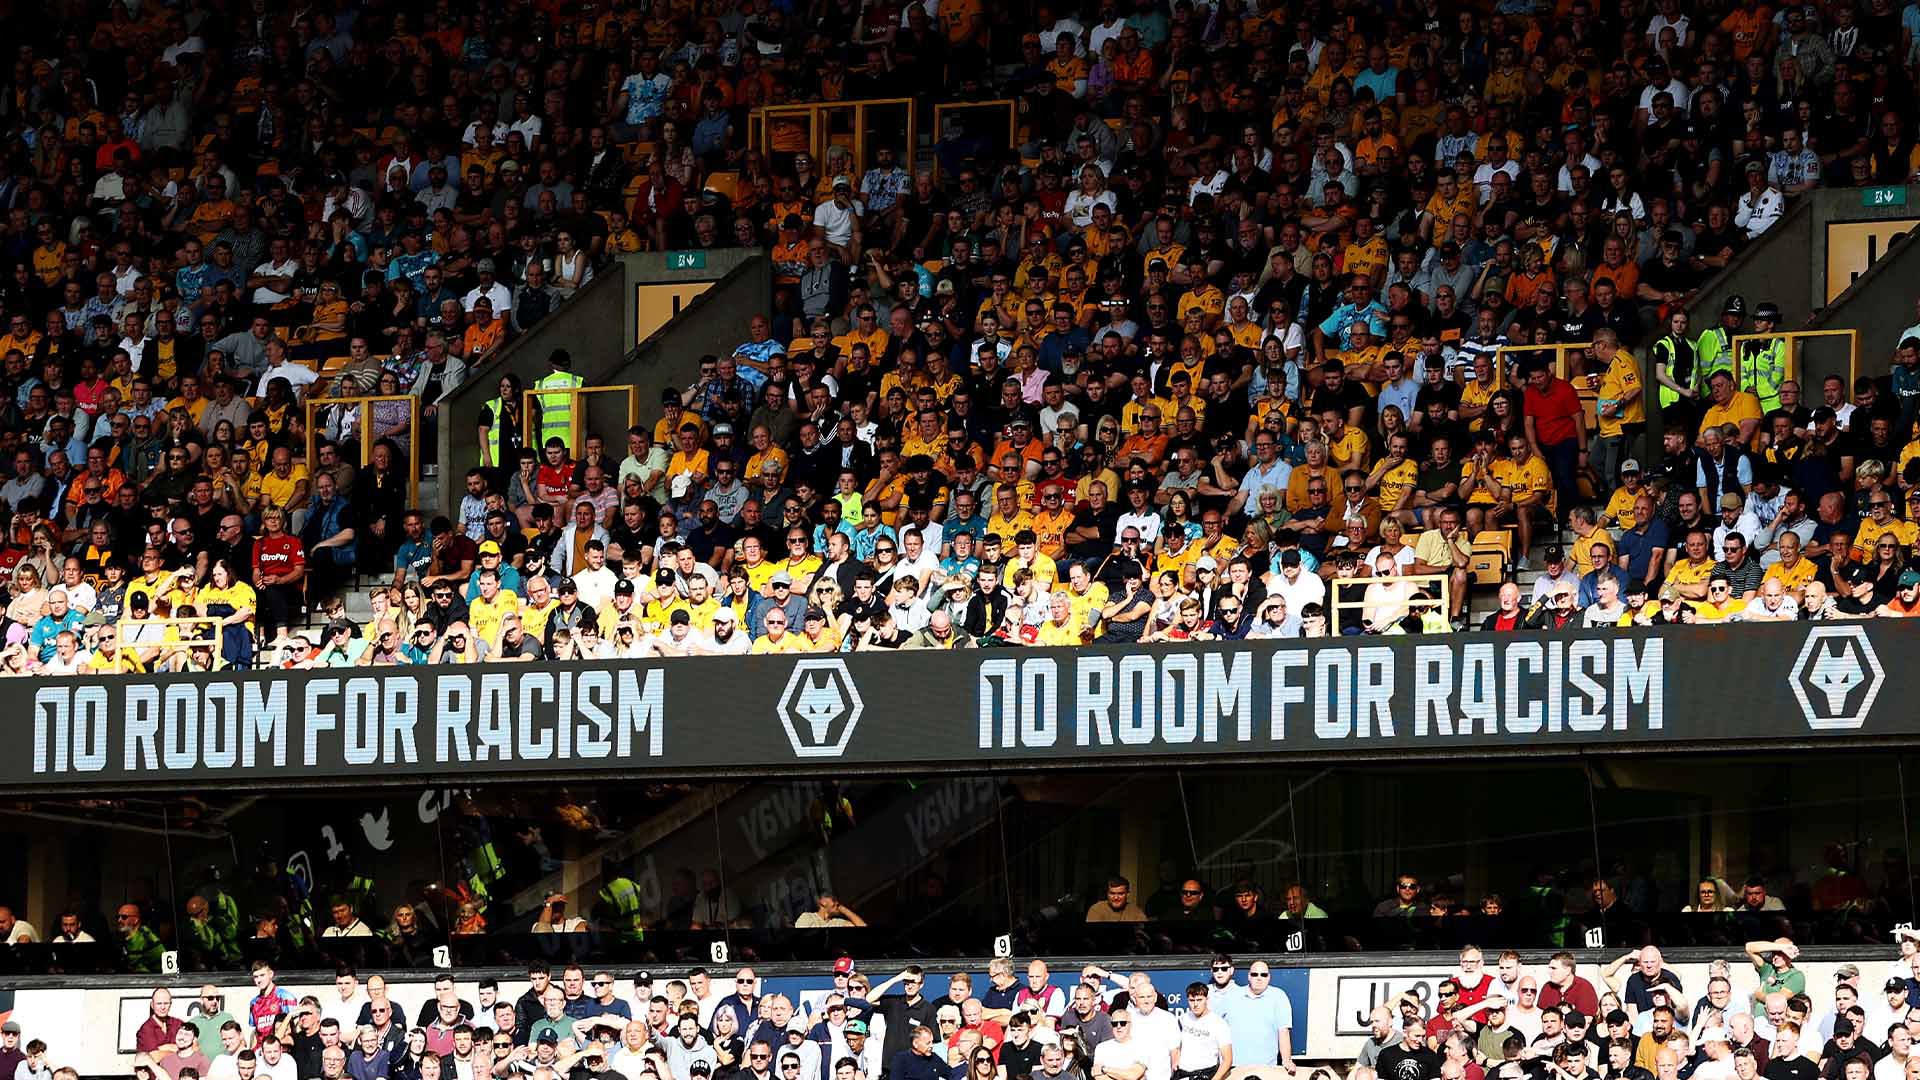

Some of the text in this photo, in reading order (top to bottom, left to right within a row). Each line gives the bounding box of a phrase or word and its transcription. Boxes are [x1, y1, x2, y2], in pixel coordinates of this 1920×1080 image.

[979, 638, 1663, 748] NO ROOM FOR RACISM
[34, 669, 664, 772] NO ROOM FOR RACISM
[1289, 933, 1301, 949] 10
[1589, 929, 1600, 945] 11
[714, 944, 723, 960] 8
[999, 938, 1007, 955] 9
[166, 955, 174, 970] 6
[438, 949, 446, 965] 7
[1167, 993, 1182, 1005] OF
